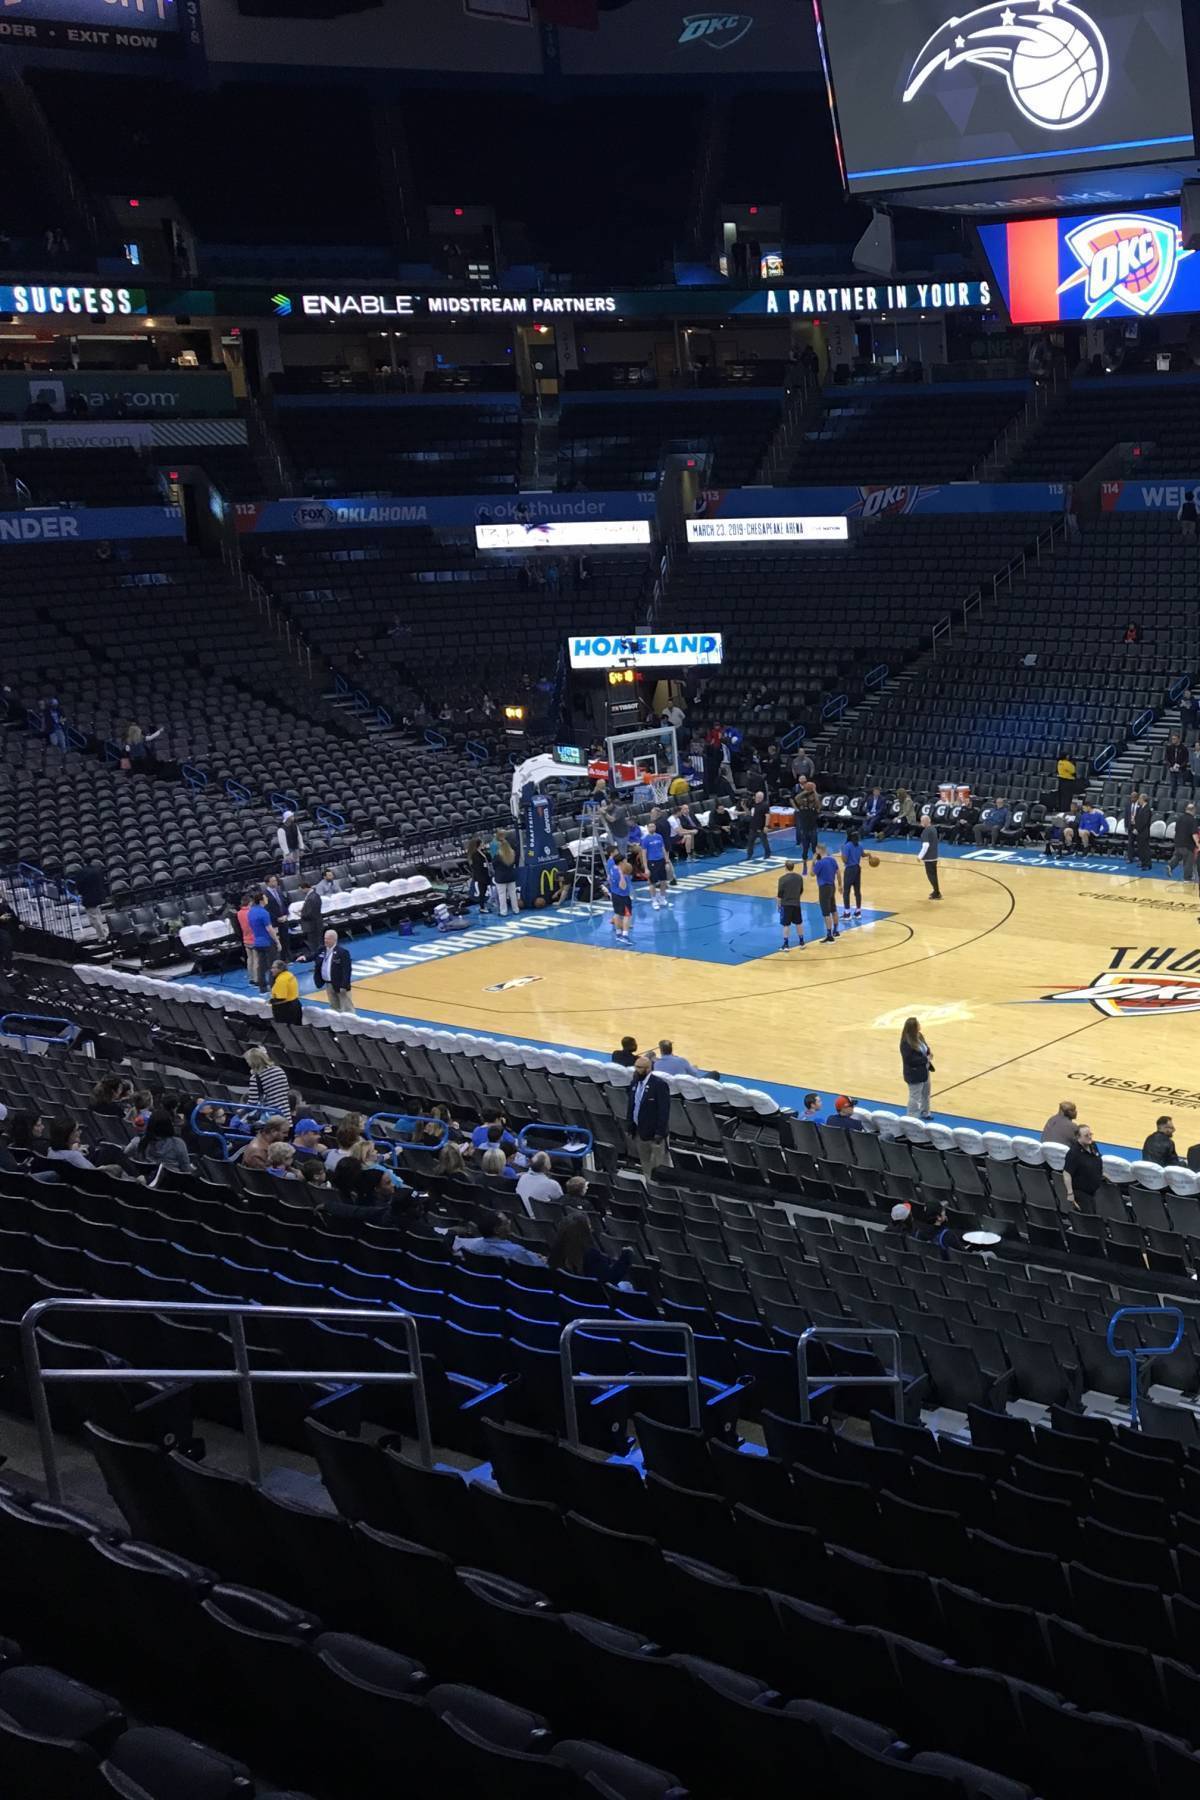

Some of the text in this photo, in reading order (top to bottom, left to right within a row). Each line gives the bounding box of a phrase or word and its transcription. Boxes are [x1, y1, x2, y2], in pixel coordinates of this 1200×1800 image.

[66, 28, 111, 44] EXIT
[115, 32, 159, 49] NOW
[1088, 230, 1155, 300] OKC
[12, 285, 132, 315] SUCCESS
[302, 294, 617, 315] ENABLE MIDSTREAM PARTNERS
[766, 289, 779, 313] A
[788, 285, 878, 313] PARTNER
[887, 284, 907, 309] IN
[916, 282, 970, 309] YOUR
[637, 493, 656, 503] 112
[1048, 485, 1064, 494] 113
[1103, 483, 1119, 495] 114
[236, 504, 257, 515] 112
[301, 506, 428, 523] FOX OKLAHOMA
[475, 499, 606, 520] @okthunder
[693, 524, 715, 537] MARCH
[574, 635, 717, 656] HOMELAND
[1002, 854, 1122, 873] paycom
